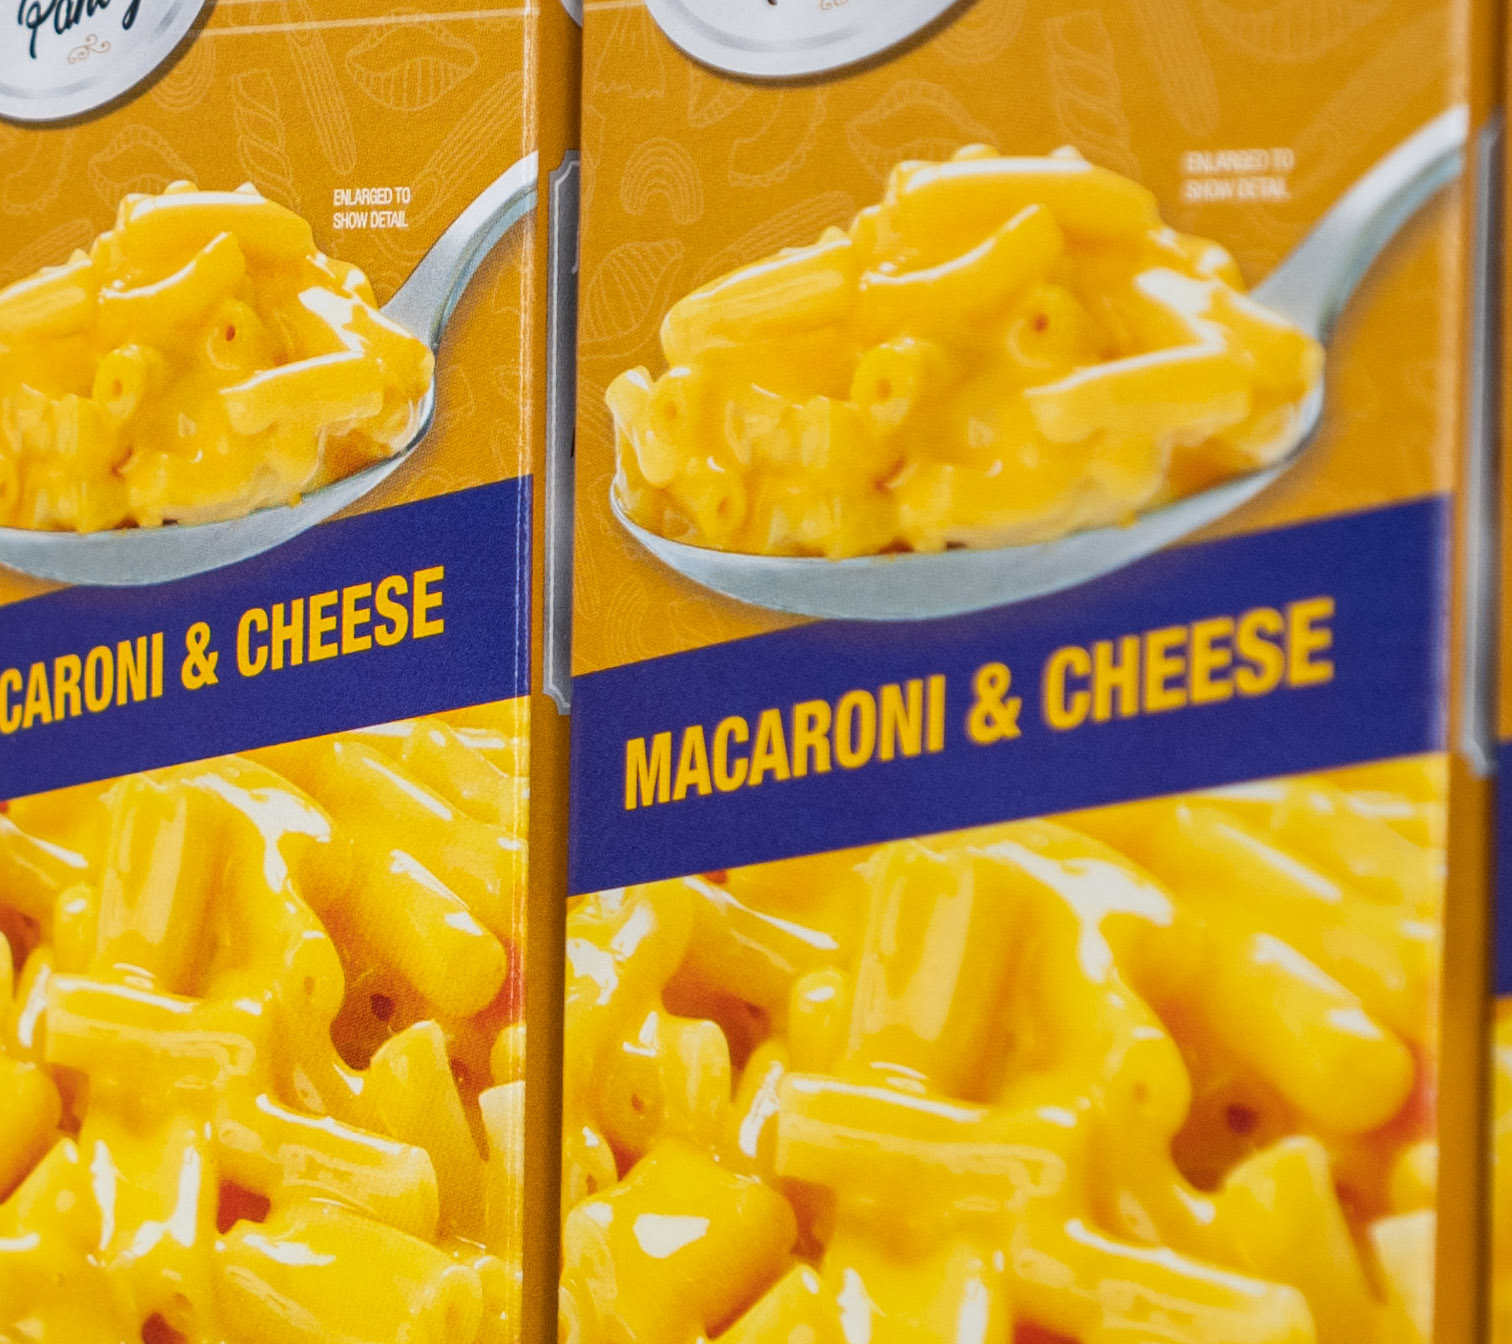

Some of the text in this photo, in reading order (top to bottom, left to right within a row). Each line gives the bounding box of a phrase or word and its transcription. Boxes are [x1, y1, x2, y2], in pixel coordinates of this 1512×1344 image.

[333, 186, 411, 206] ENLARGED TO
[333, 210, 409, 229] SHOW DETAIL
[180, 621, 219, 690] &
[236, 565, 446, 676] CHEESE
[623, 597, 1337, 811] MACARONI & CHEESE
